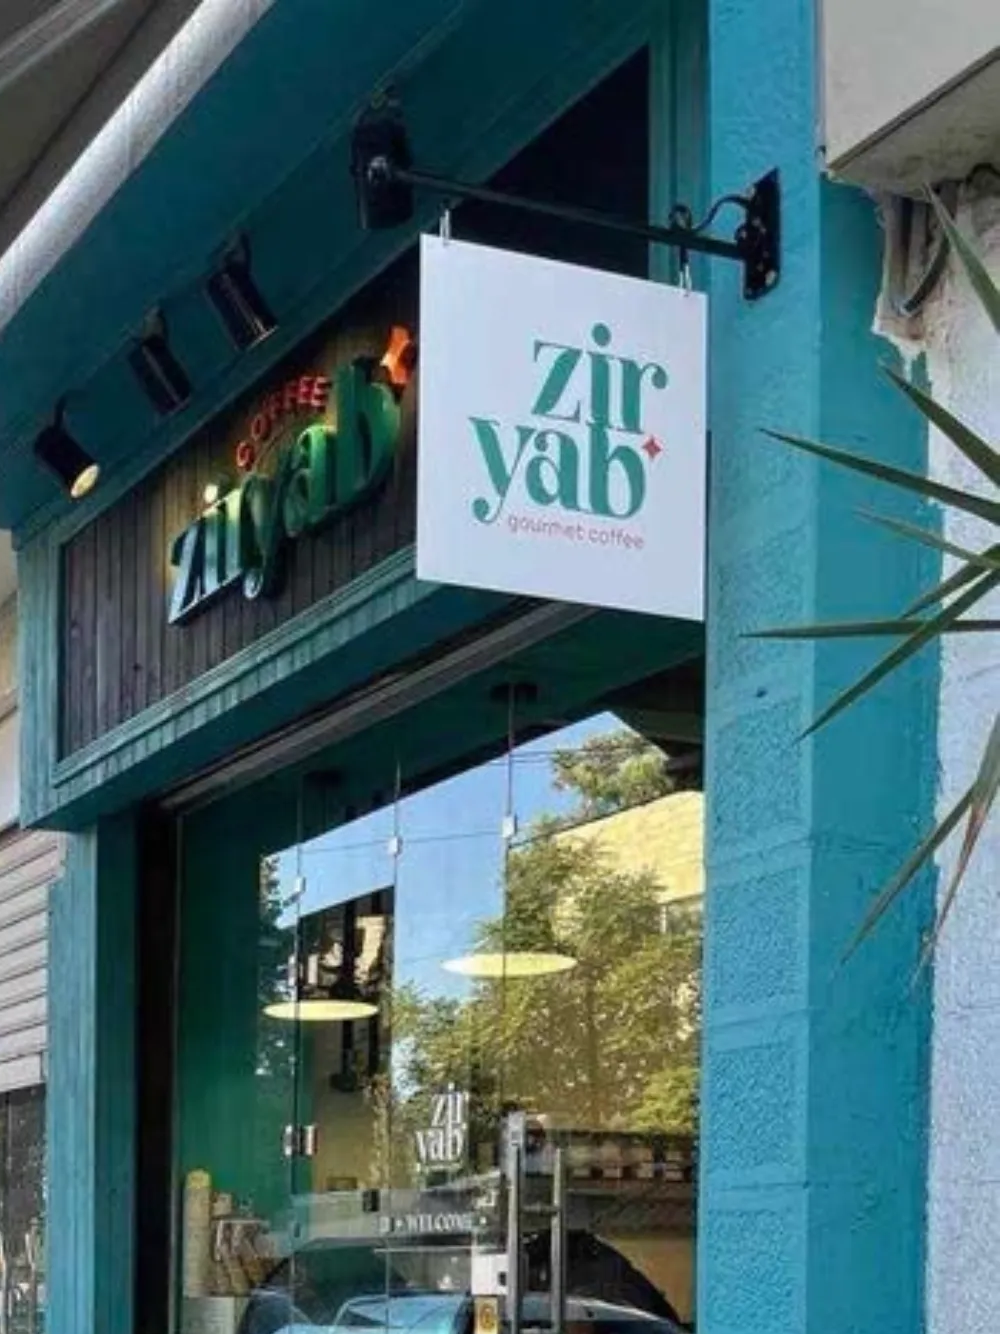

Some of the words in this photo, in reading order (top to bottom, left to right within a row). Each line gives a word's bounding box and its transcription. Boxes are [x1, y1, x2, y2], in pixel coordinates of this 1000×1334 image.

[235, 376, 332, 470] COFFEE
[531, 322, 668, 434] zir
[468, 415, 646, 524] yab
[508, 513, 585, 541] gourmet
[588, 527, 645, 550] coffee
